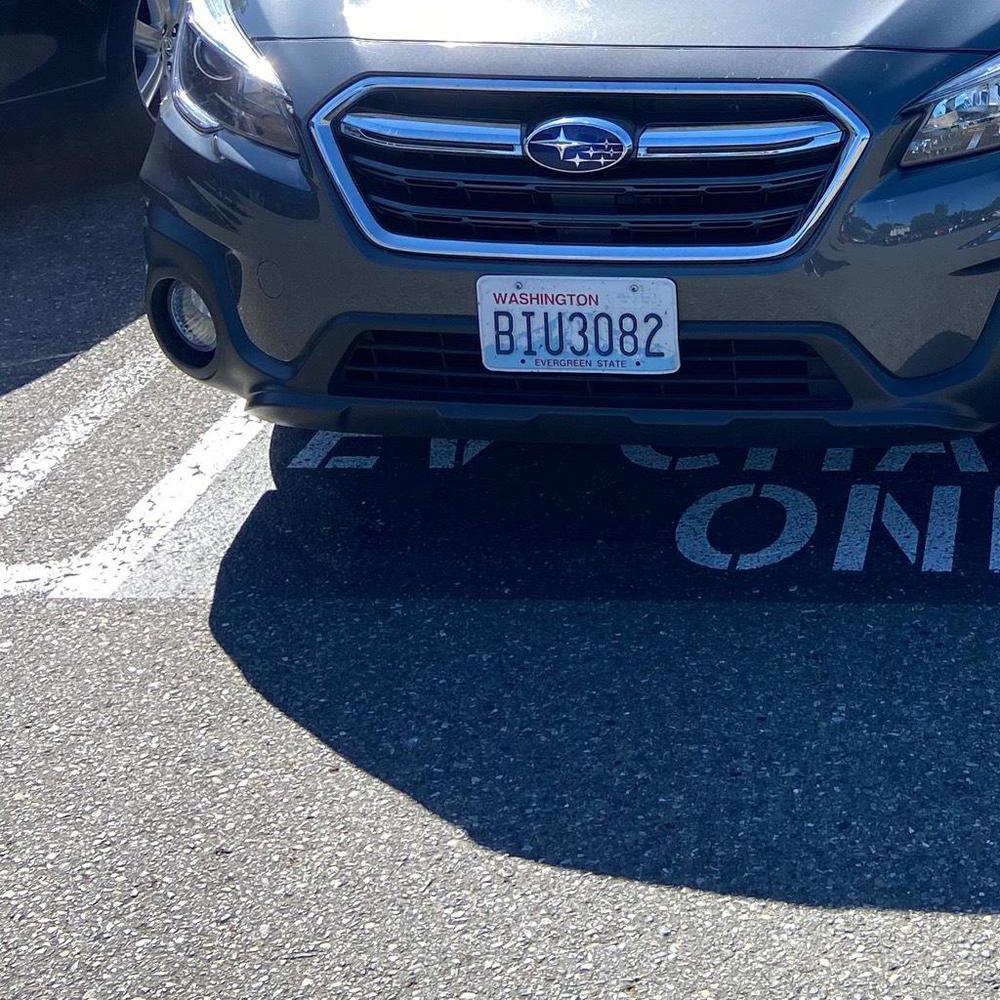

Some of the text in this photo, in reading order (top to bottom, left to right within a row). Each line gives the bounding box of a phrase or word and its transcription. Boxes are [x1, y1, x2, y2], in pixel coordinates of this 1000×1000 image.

[492, 292, 599, 307] WASHINGTON
[493, 310, 666, 358] BIU3082
[534, 358, 628, 369] EVERGREEN STATE
